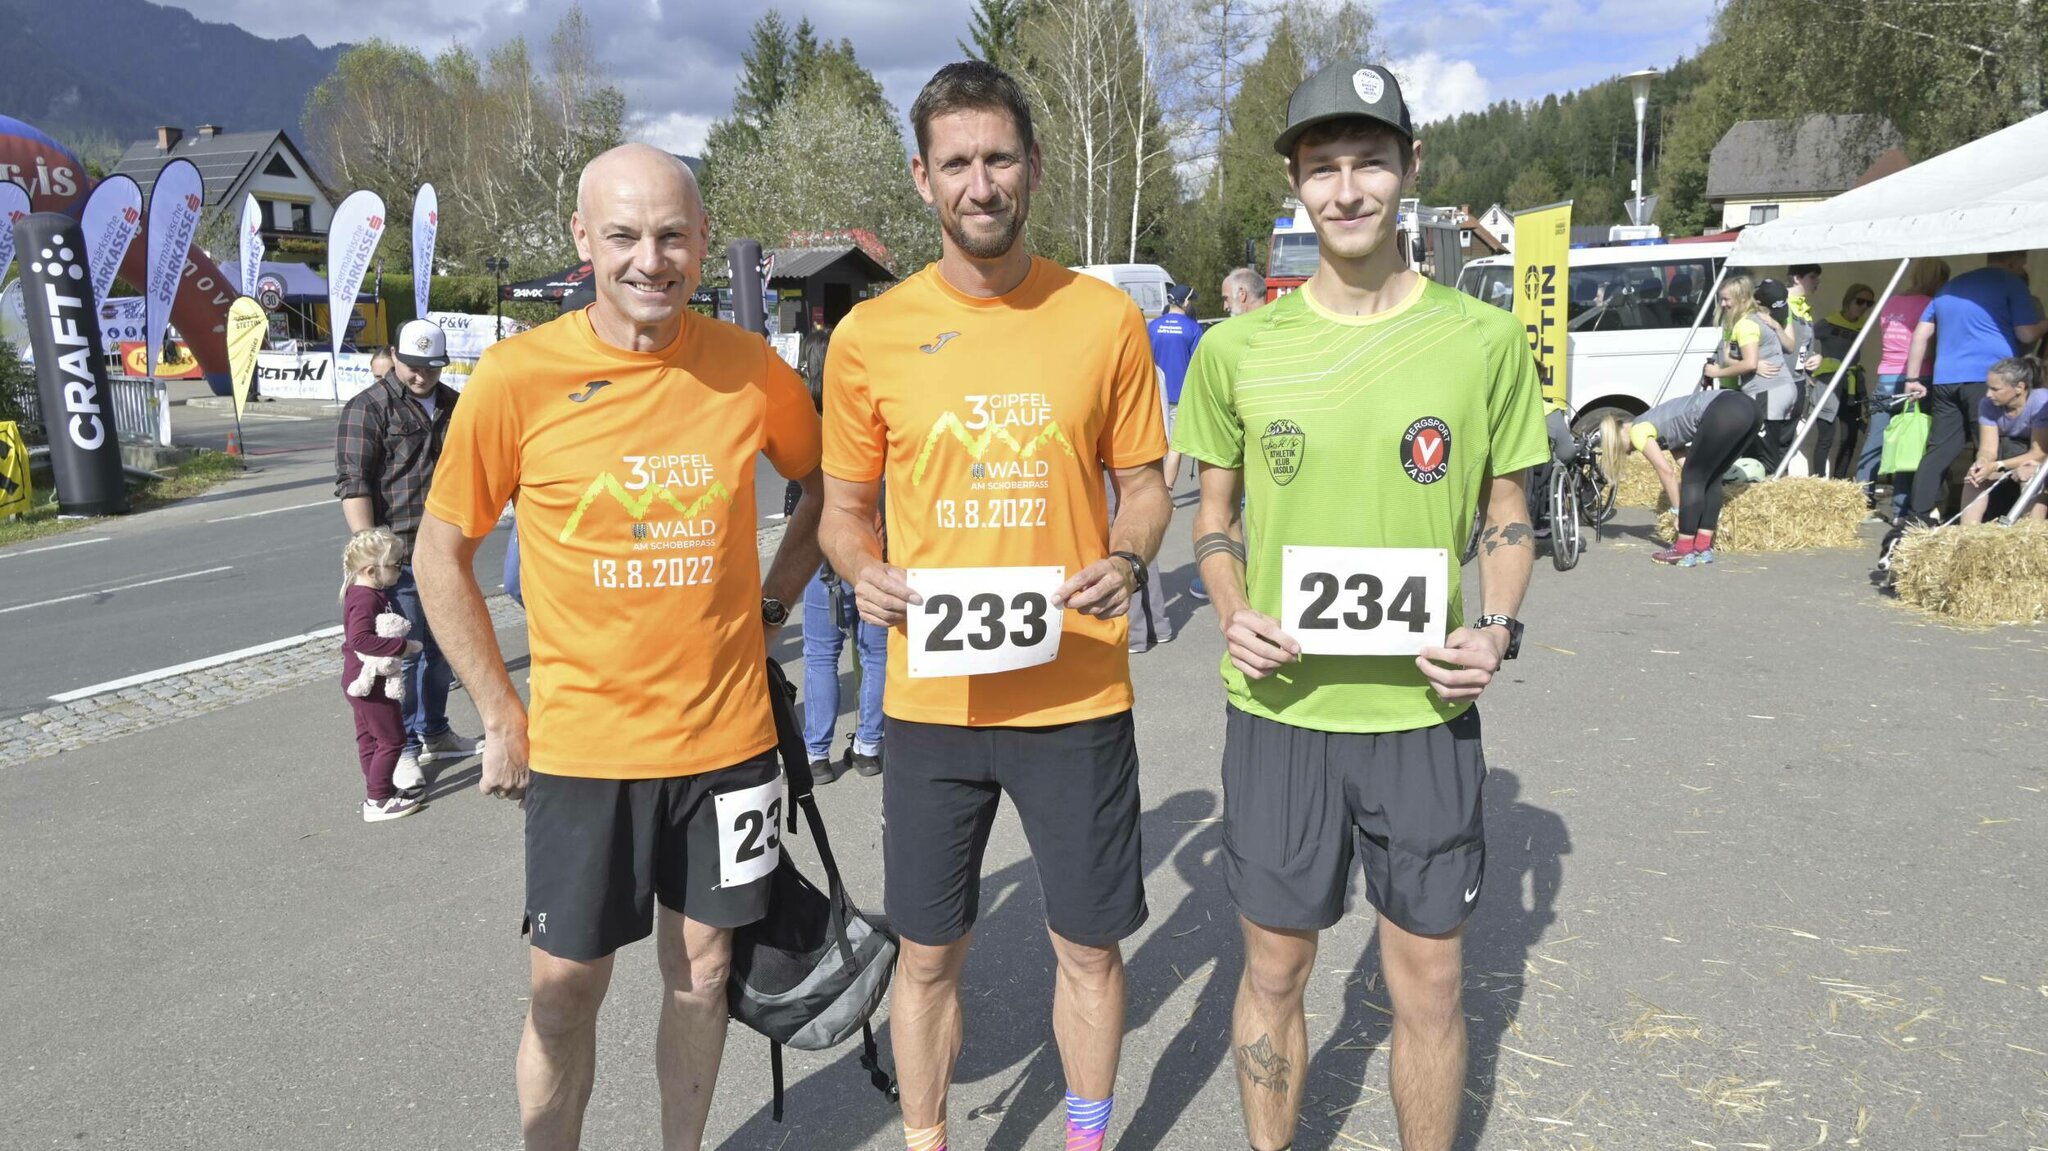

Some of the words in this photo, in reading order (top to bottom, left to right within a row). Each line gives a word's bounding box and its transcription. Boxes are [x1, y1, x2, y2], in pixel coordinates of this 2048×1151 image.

[159, 211, 195, 305] SPARKASSE
[341, 229, 377, 304] SPARKASSE
[421, 226, 435, 306] SPARKASSE
[265, 294, 276, 306] 30
[513, 288, 543, 298] 24MX
[440, 316, 472, 329] P&W
[45, 283, 105, 450] CRAFT
[965, 395, 989, 429] 3
[989, 393, 1052, 408] GIPFEL
[991, 408, 1052, 428] LAUF
[1404, 418, 1450, 441] BERGSPORT
[1275, 458, 1290, 466] KLUB
[1416, 436, 1442, 466] V
[623, 455, 649, 490] 3
[648, 453, 713, 470] GIPFEL
[650, 468, 714, 488] LAUF
[987, 460, 1049, 478] WALD
[1272, 466, 1294, 475] VASOLD
[1404, 458, 1447, 483] VASOLD
[970, 482, 986, 490] AM
[987, 480, 1049, 489] SCHOBERPASS
[935, 497, 1046, 529] 13.8.2022
[649, 519, 716, 538] WALD
[632, 541, 649, 551] AM
[650, 538, 716, 550] SCHOBERPASS
[592, 556, 714, 589] 13.8.2022
[1298, 571, 1431, 633] 234
[924, 591, 1048, 652] 233
